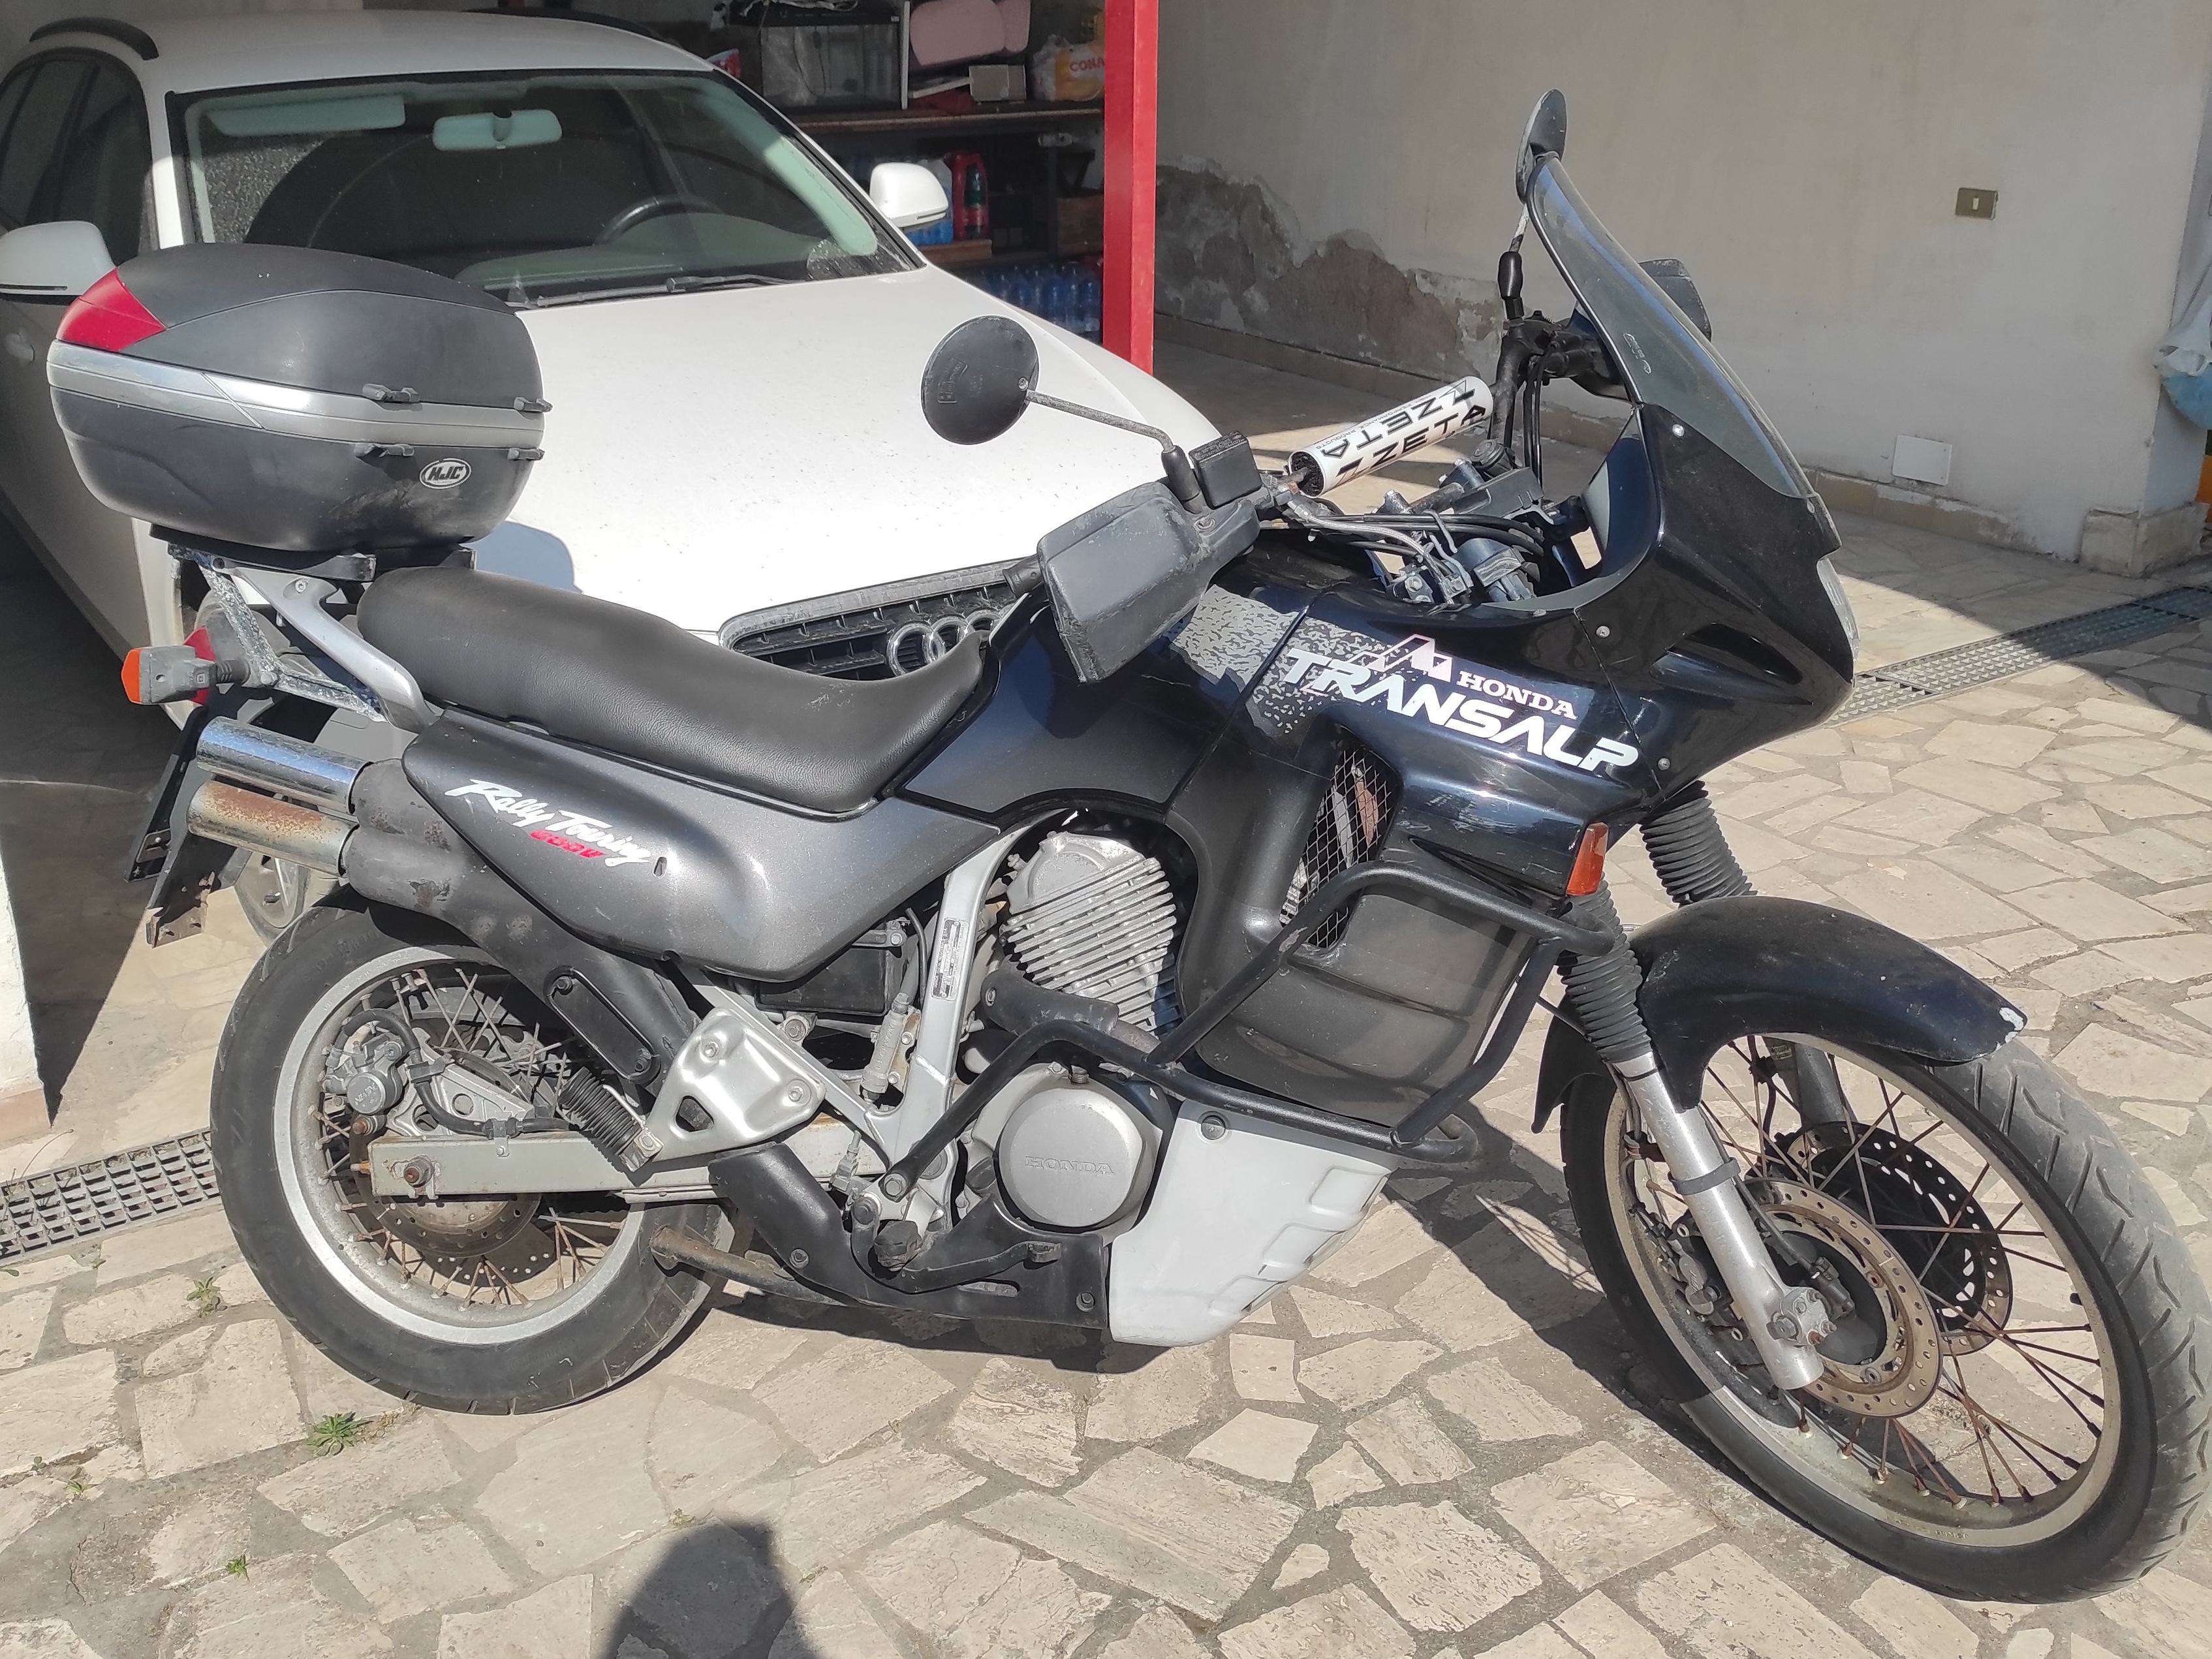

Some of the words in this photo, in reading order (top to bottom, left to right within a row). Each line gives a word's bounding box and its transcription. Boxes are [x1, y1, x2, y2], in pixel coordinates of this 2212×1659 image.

[1320, 397, 1443, 459] ZETA
[1371, 404, 1487, 469] ZETA
[1281, 647, 1640, 772] TRANSALP
[1456, 670, 1578, 721] HONDA
[444, 779, 555, 828] Rally
[544, 809, 652, 867] Touring
[1024, 1155, 1115, 1176] HONDA
